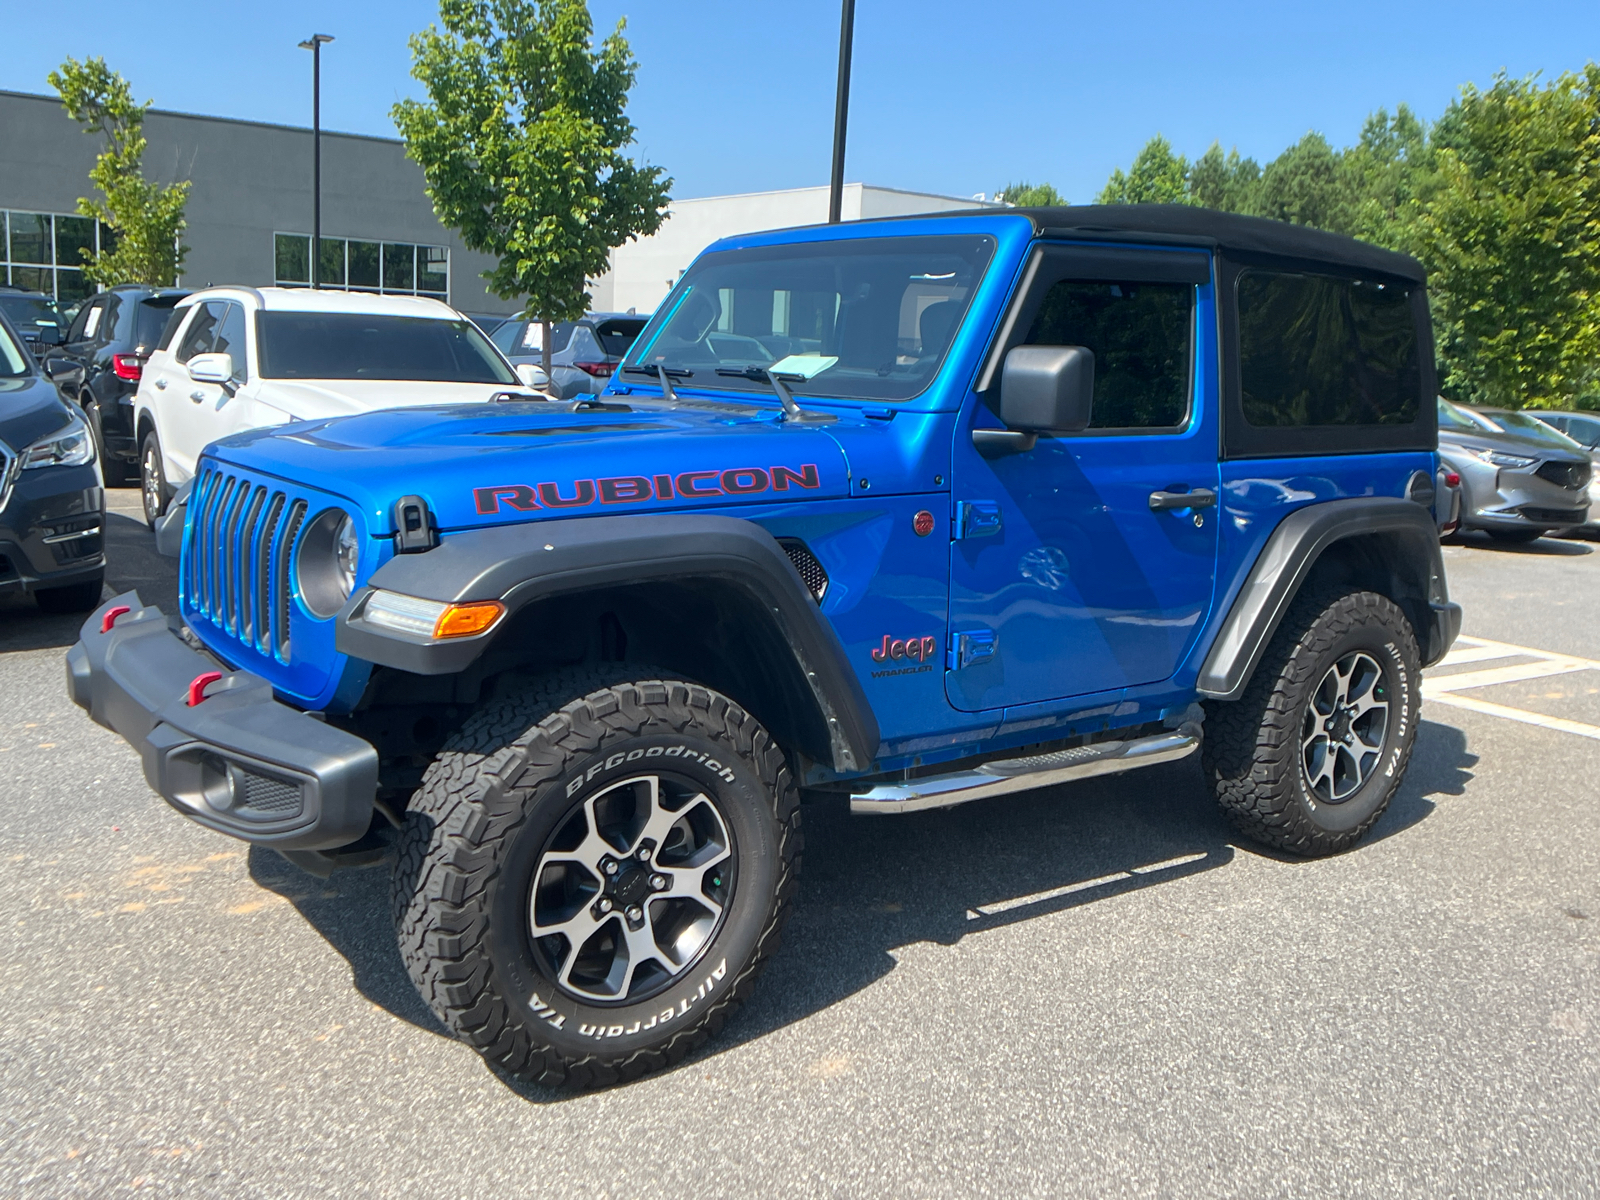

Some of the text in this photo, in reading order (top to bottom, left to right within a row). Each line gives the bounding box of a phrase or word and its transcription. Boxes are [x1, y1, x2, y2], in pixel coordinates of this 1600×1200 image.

[473, 463, 821, 515] RUBICON
[871, 634, 936, 662] Jeep
[871, 664, 933, 679] WRANGLER
[1384, 642, 1408, 778] All-Terrain T/A
[565, 744, 736, 798] BFGoodrich
[527, 992, 568, 1031] T/A
[578, 957, 728, 1041] All-Terrain
